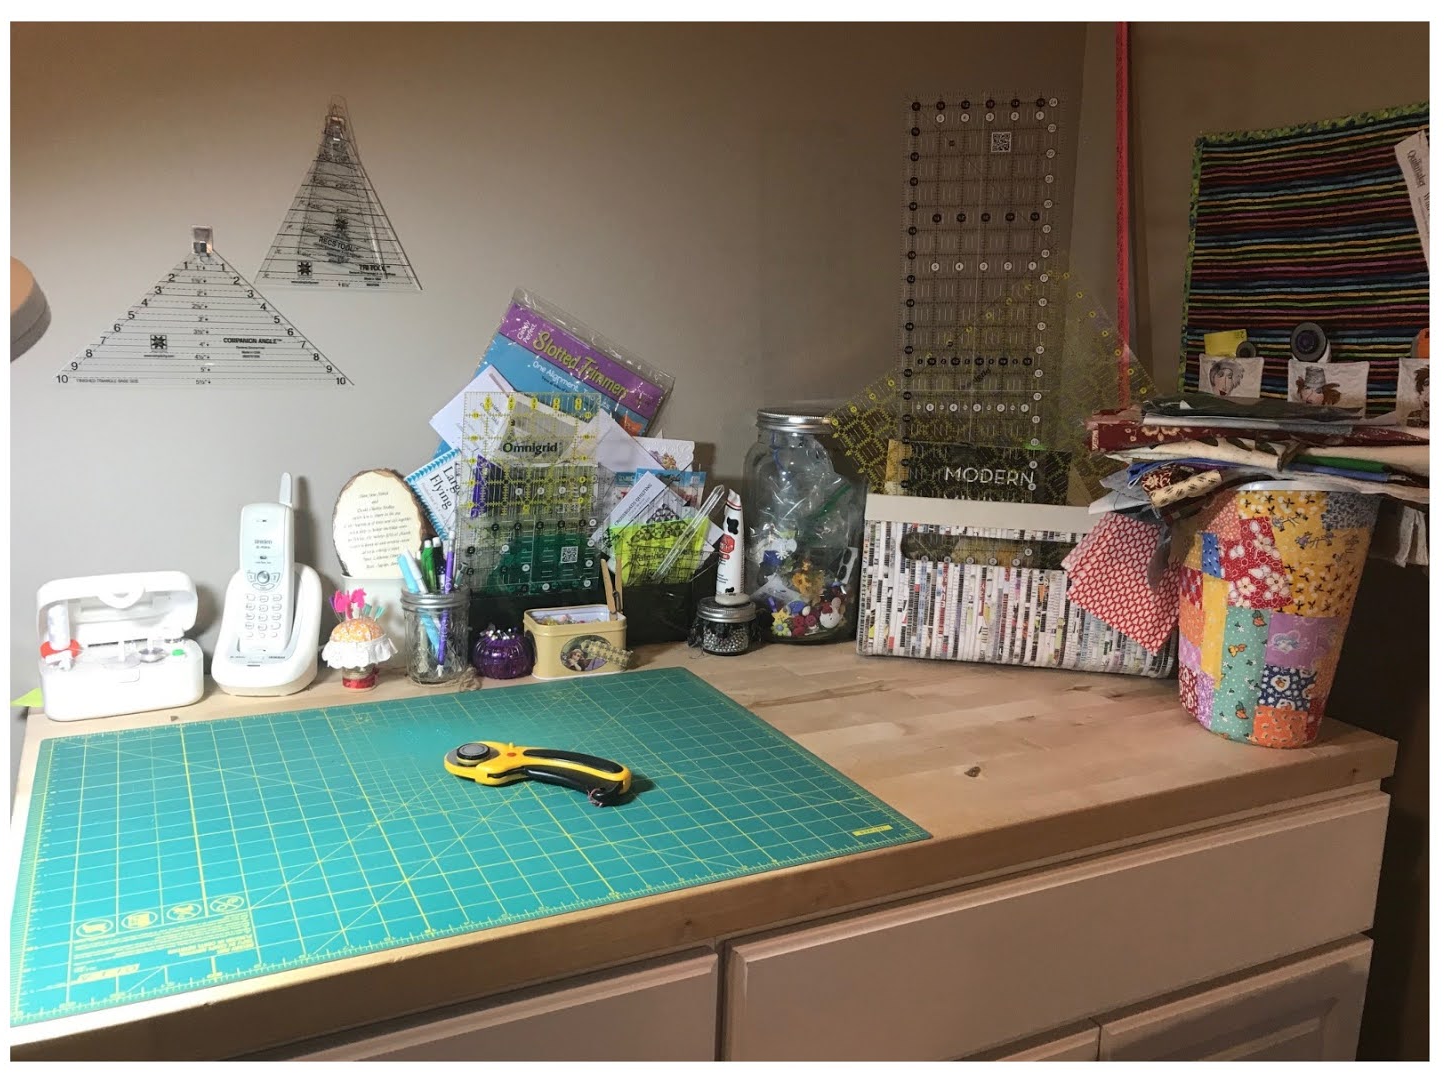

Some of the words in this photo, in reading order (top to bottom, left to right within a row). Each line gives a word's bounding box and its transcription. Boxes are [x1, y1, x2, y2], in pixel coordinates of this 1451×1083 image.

[183, 261, 188, 269] 1
[221, 263, 225, 271] 1
[168, 273, 176, 281] 2
[233, 276, 240, 285] 2
[154, 285, 162, 294] 3
[247, 289, 254, 298] 3
[141, 298, 148, 307] 4
[260, 302, 267, 310] 4
[128, 311, 135, 319] 5
[273, 315, 280, 324] 5
[113, 323, 121, 332] 6
[287, 328, 294, 336] 6
[100, 336, 106, 344] 7
[300, 341, 306, 349] 7
[85, 349, 93, 358] 8
[533, 331, 582, 370] Slotted
[313, 353, 320, 361] 8
[71, 361, 78, 370] 9
[326, 365, 333, 373] 9
[56, 374, 68, 383] 10
[336, 377, 346, 385] 10
[502, 442, 558, 455] Omnigrid
[944, 466, 1035, 486] MODERN
[429, 474, 453, 513] Flying
